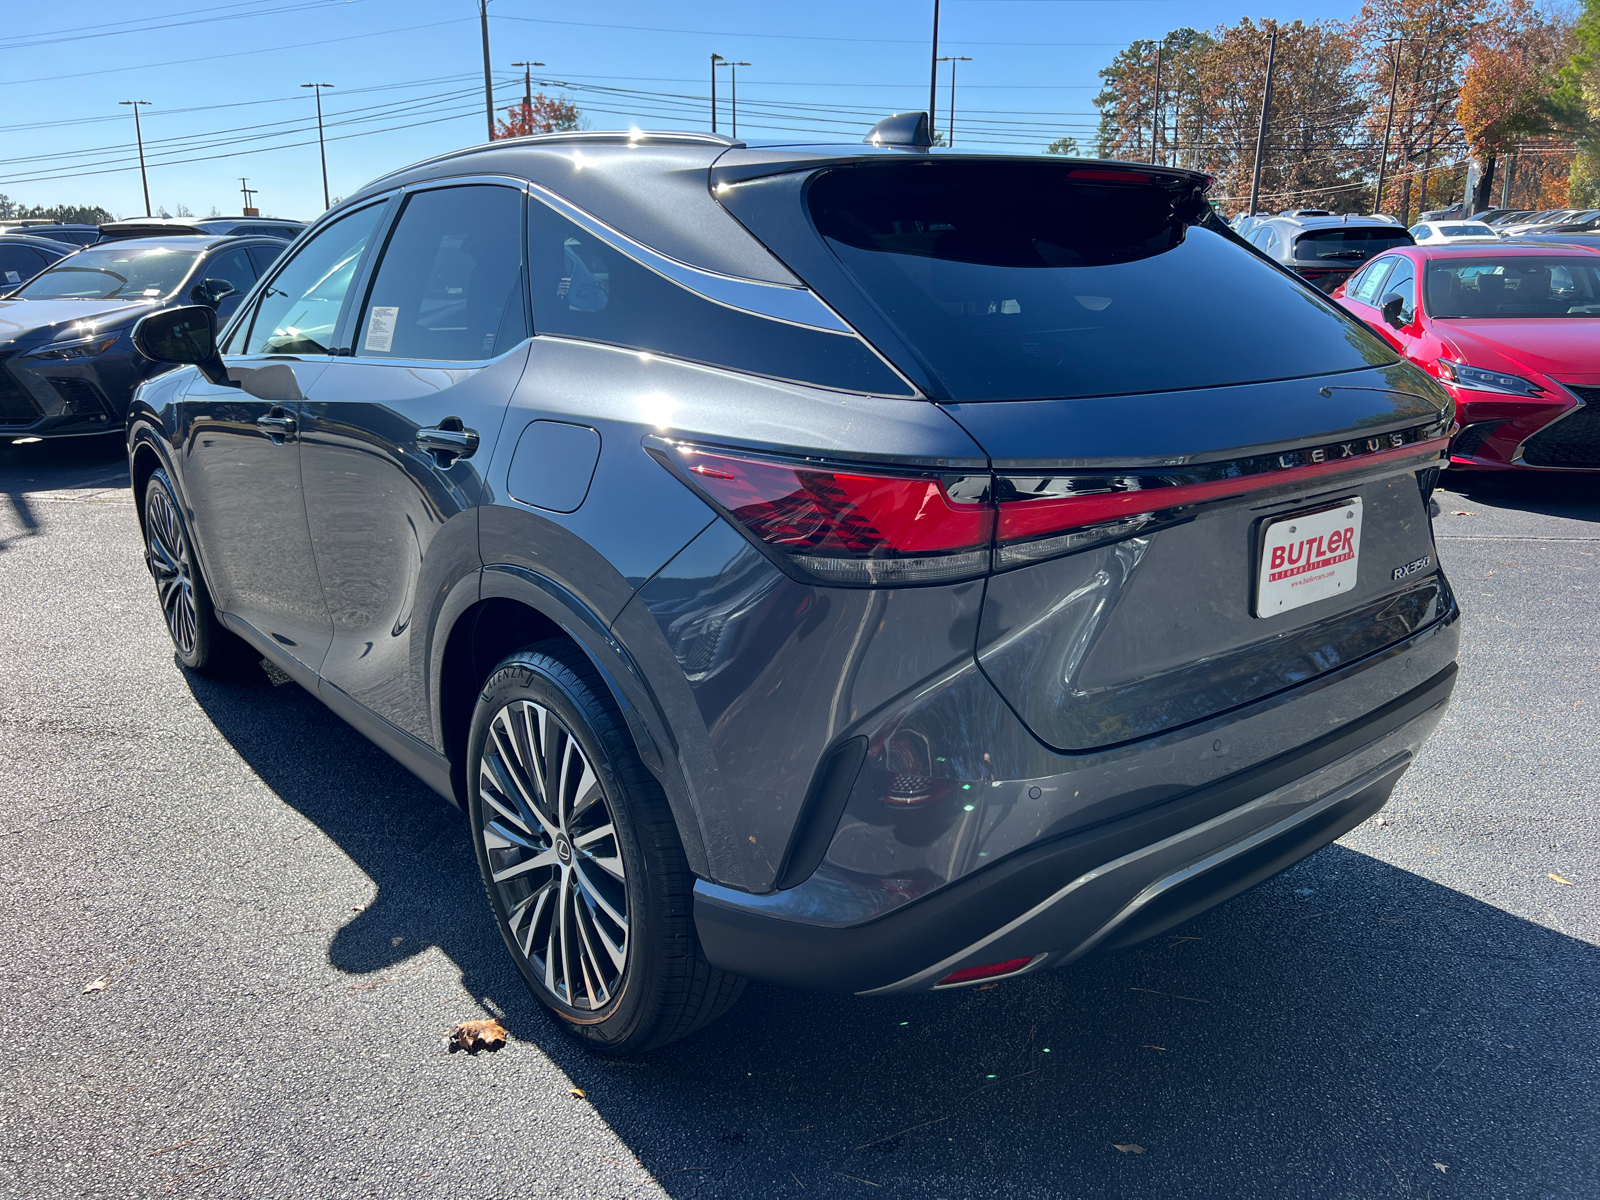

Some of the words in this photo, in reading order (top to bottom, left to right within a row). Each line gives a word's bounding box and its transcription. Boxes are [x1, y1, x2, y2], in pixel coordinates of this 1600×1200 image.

[1279, 434, 1403, 468] LEXUS
[1269, 561, 1322, 581] AUTOMOTIVE
[1330, 551, 1354, 565] GROUP
[1393, 556, 1431, 580] RX350
[1291, 571, 1336, 588] www.butlercars.com
[487, 667, 524, 692] ALENZA
